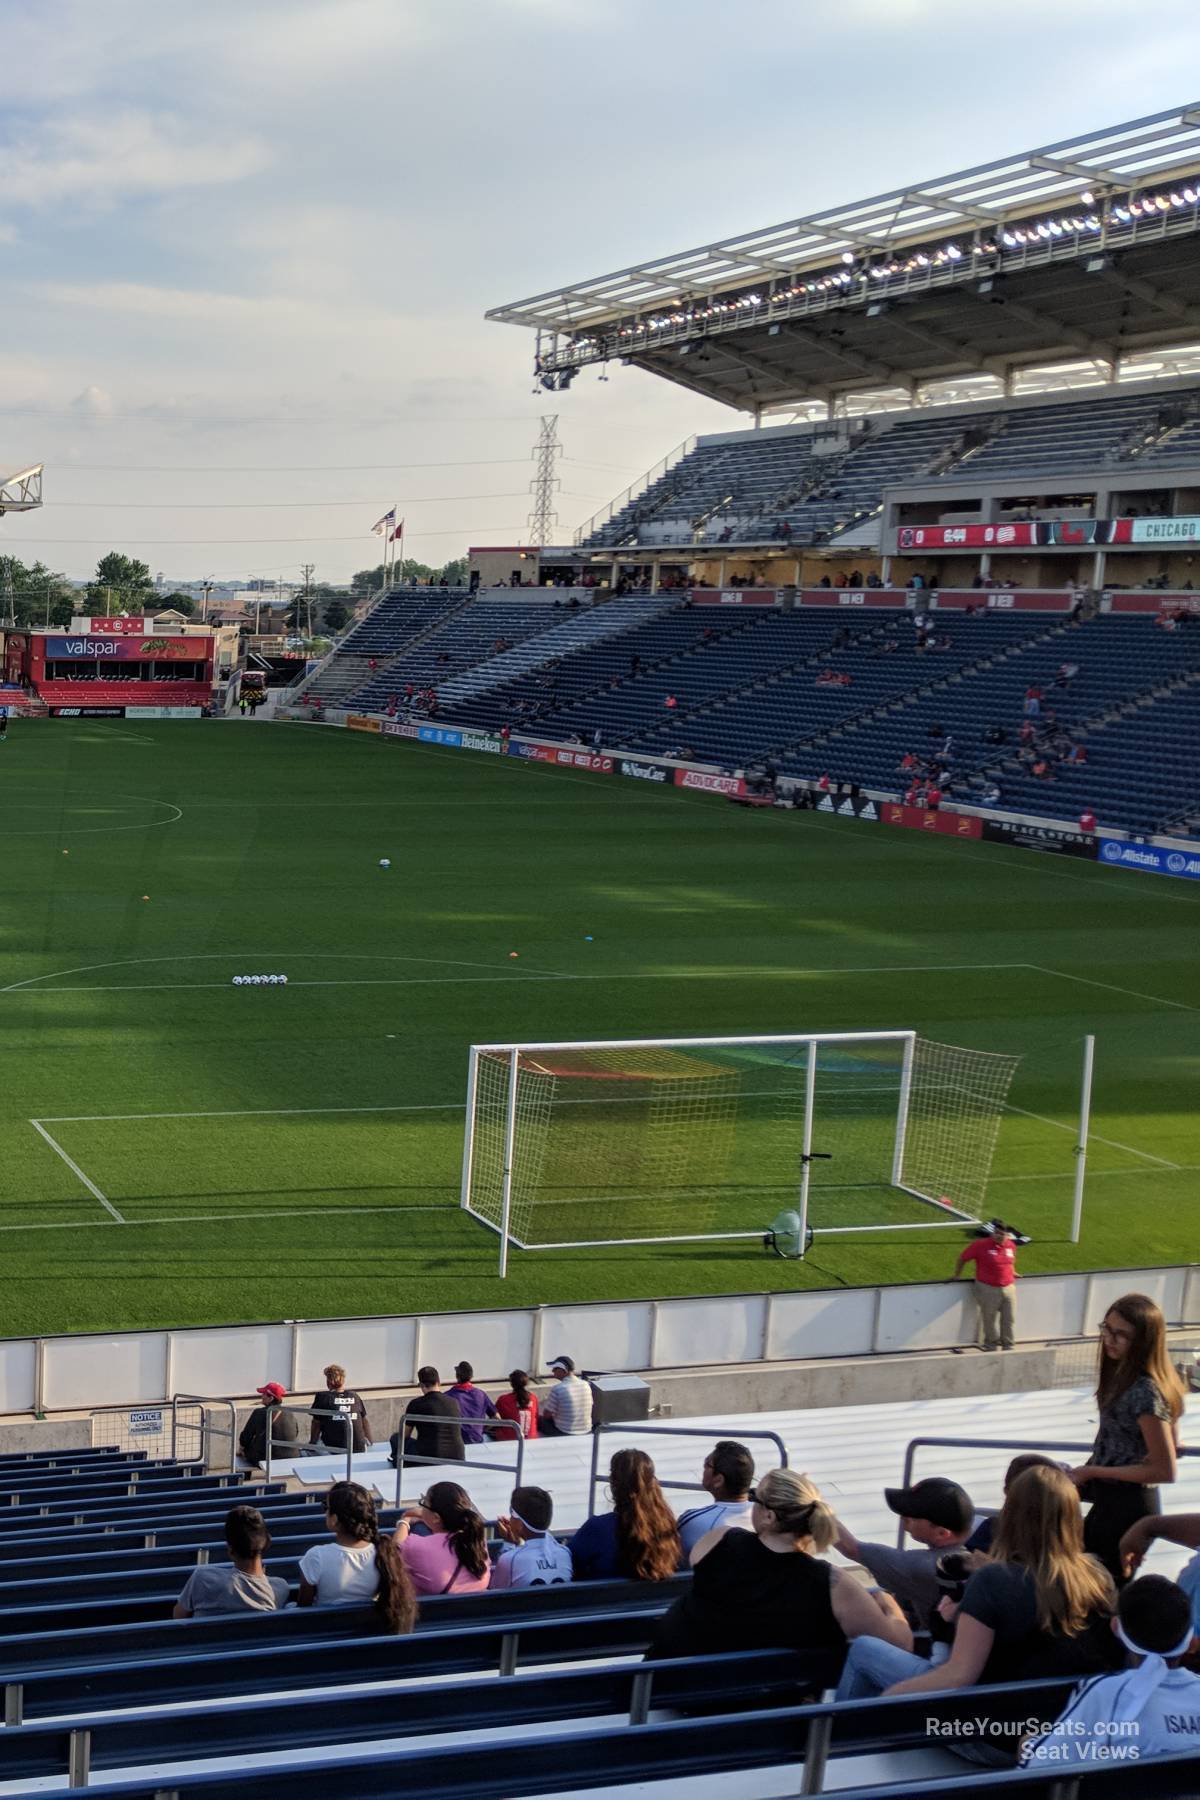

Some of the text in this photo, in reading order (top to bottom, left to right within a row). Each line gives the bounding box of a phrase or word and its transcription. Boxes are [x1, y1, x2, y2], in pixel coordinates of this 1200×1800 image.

[1146, 522, 1196, 537] CHICAGO
[65, 637, 121, 658] valspar
[461, 733, 500, 753] Heineken
[630, 762, 667, 782] NovaCare
[682, 771, 738, 793] ADVOCARE
[1121, 849, 1160, 867] Allstate
[131, 1411, 161, 1422] NOTICE
